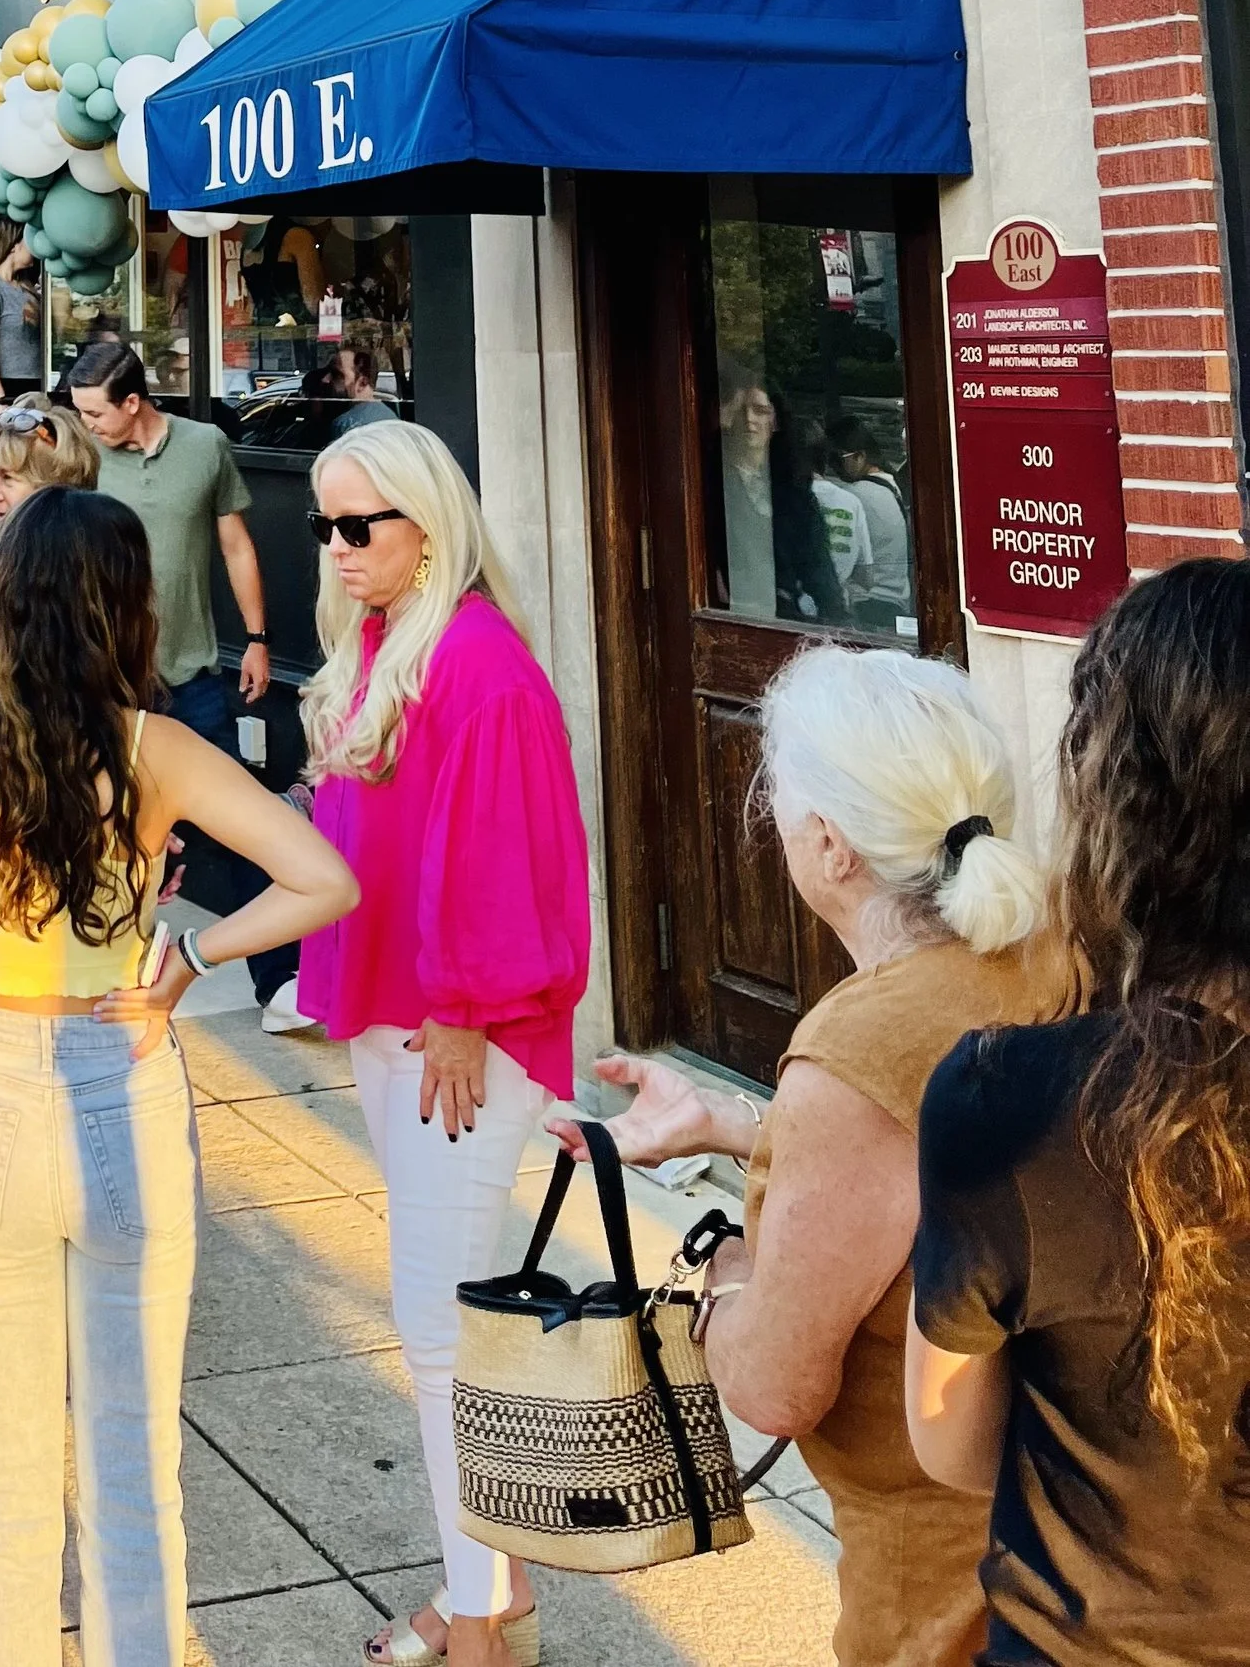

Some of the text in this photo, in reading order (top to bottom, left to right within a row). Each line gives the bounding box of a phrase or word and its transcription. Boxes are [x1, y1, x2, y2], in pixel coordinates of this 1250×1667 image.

[200, 71, 374, 191] 100 E.
[1002, 231, 1044, 261] 100
[1007, 263, 1043, 283] East
[956, 313, 977, 329] 201
[983, 307, 1059, 320] JONATHAN ALDERSON
[984, 319, 1089, 332] LANDSCAPE ARCHITECTS, INC.
[960, 346, 983, 363] 203
[987, 343, 1104, 354] MAURICE WEINTRAUB ARCHITECT
[988, 357, 1078, 368] ANN ROTHMAN, ENGINEER
[962, 382, 1059, 399] 204 DEVINE DESIGNS
[1021, 445, 1053, 467] 300
[999, 497, 1083, 527] RADNOR
[992, 527, 1095, 560] PROPERTY
[1009, 560, 1081, 590] GROUP
